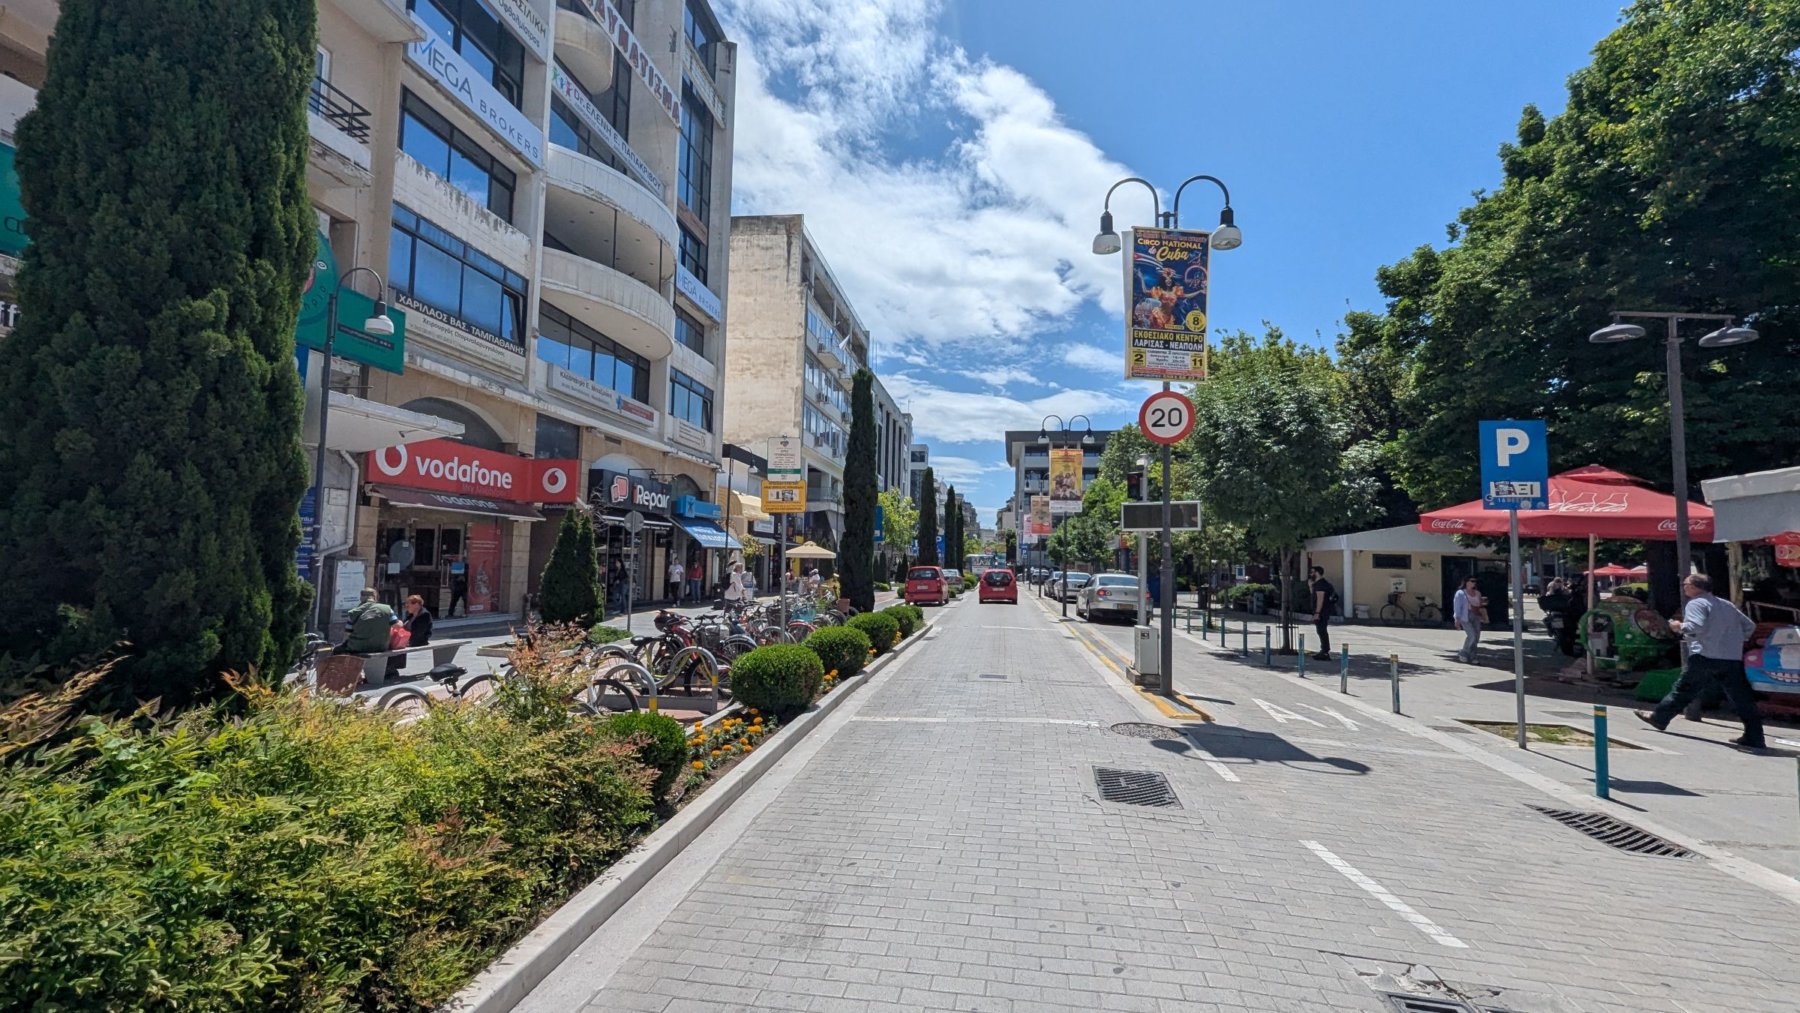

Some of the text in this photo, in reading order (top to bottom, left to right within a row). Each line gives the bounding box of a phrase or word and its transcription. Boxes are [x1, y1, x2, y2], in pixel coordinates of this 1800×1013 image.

[413, 38, 474, 104] MEGA
[479, 98, 539, 160] BROKERS
[1137, 238, 1202, 250] CIRCO NATIONAL
[1156, 246, 1189, 261] Cuba
[399, 293, 449, 323] ΧΑΡΙΛΑΟΣ
[450, 315, 469, 333] ΒΑΣ.
[1192, 316, 1200, 326] 8
[1134, 331, 1203, 343] ΕΚΘΕΣΙΑΚΟ ΚΕΝΤΡΟ
[1133, 340, 1165, 348] ΛΑΡΙΣΑΣ
[1169, 342, 1203, 350] ΝΕΑΠΟΛΗ
[1134, 353, 1144, 362] 2
[1191, 358, 1203, 367] 11
[1151, 407, 1183, 428] 20
[1496, 428, 1530, 467] P
[415, 456, 513, 489] vodafone
[632, 482, 670, 510] iRepair
